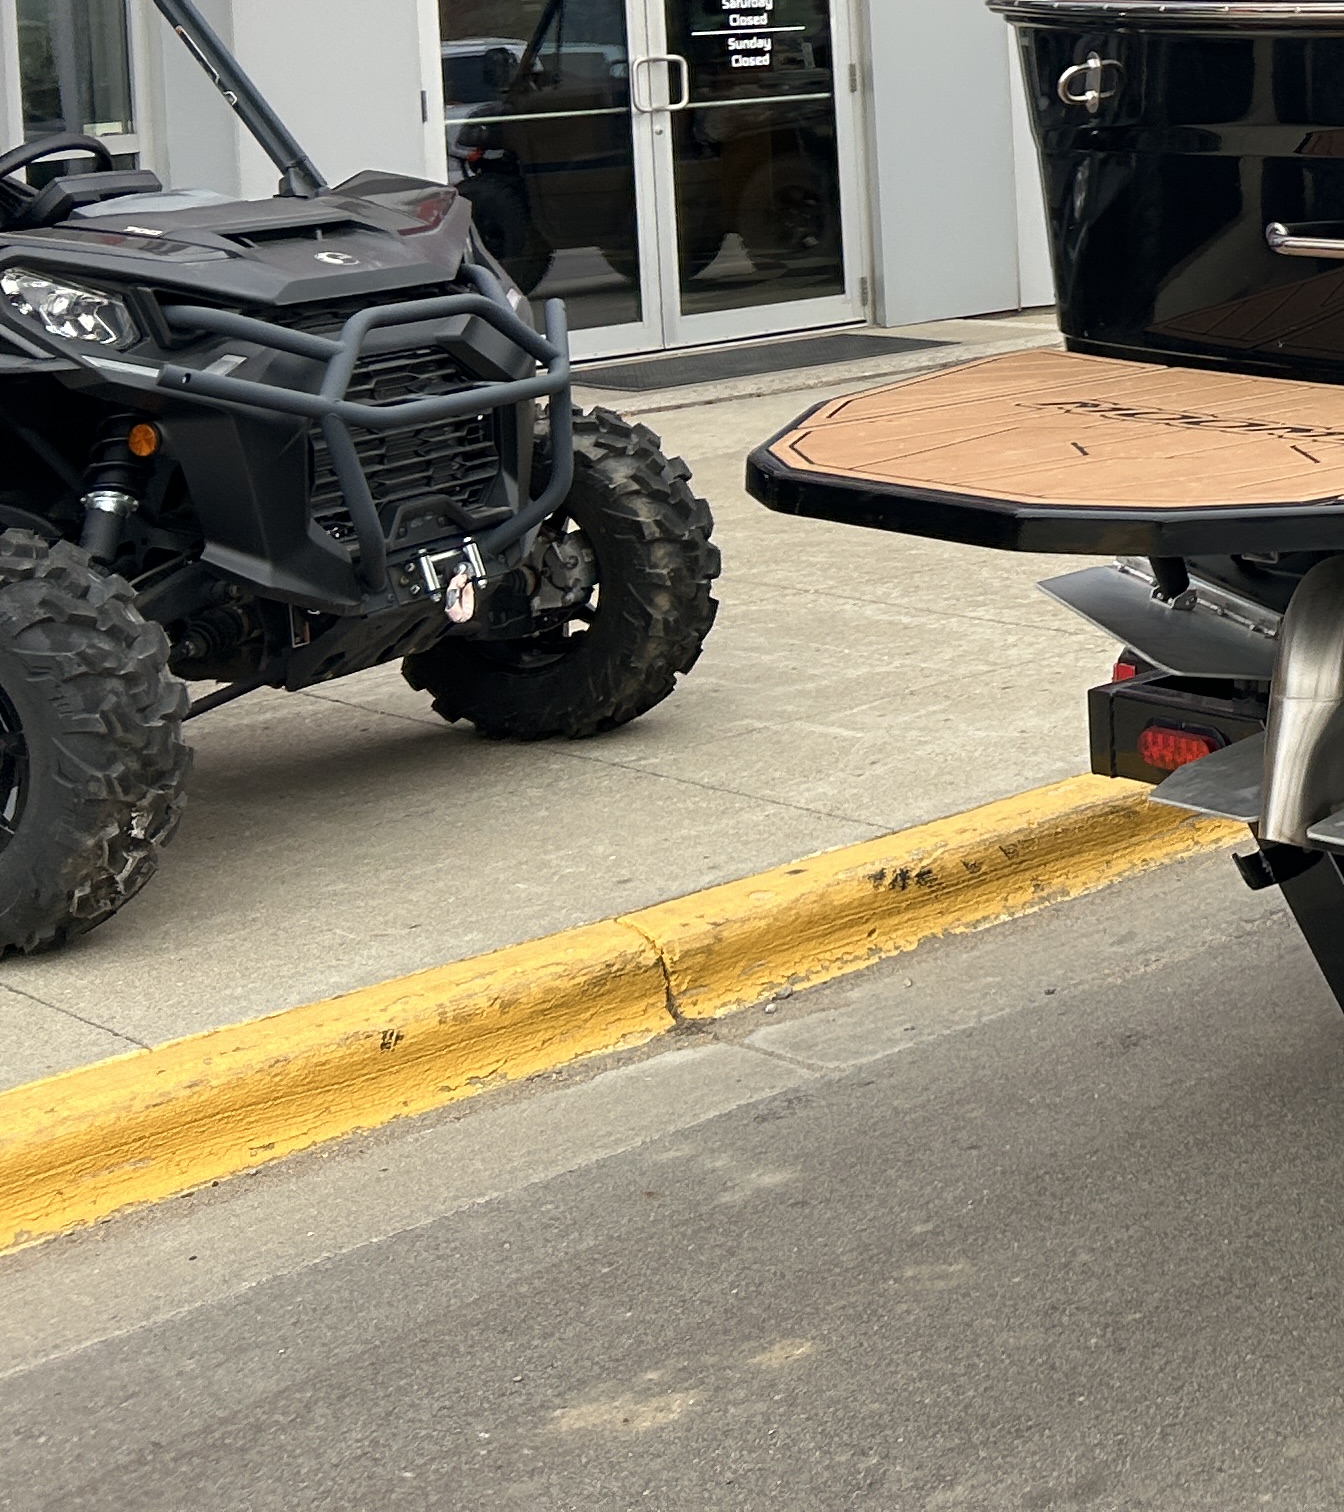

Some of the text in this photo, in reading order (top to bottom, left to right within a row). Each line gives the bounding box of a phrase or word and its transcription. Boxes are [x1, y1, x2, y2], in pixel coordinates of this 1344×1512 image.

[729, 12, 768, 27] Closed
[728, 36, 772, 51] Sunday
[731, 52, 770, 68] Closed
